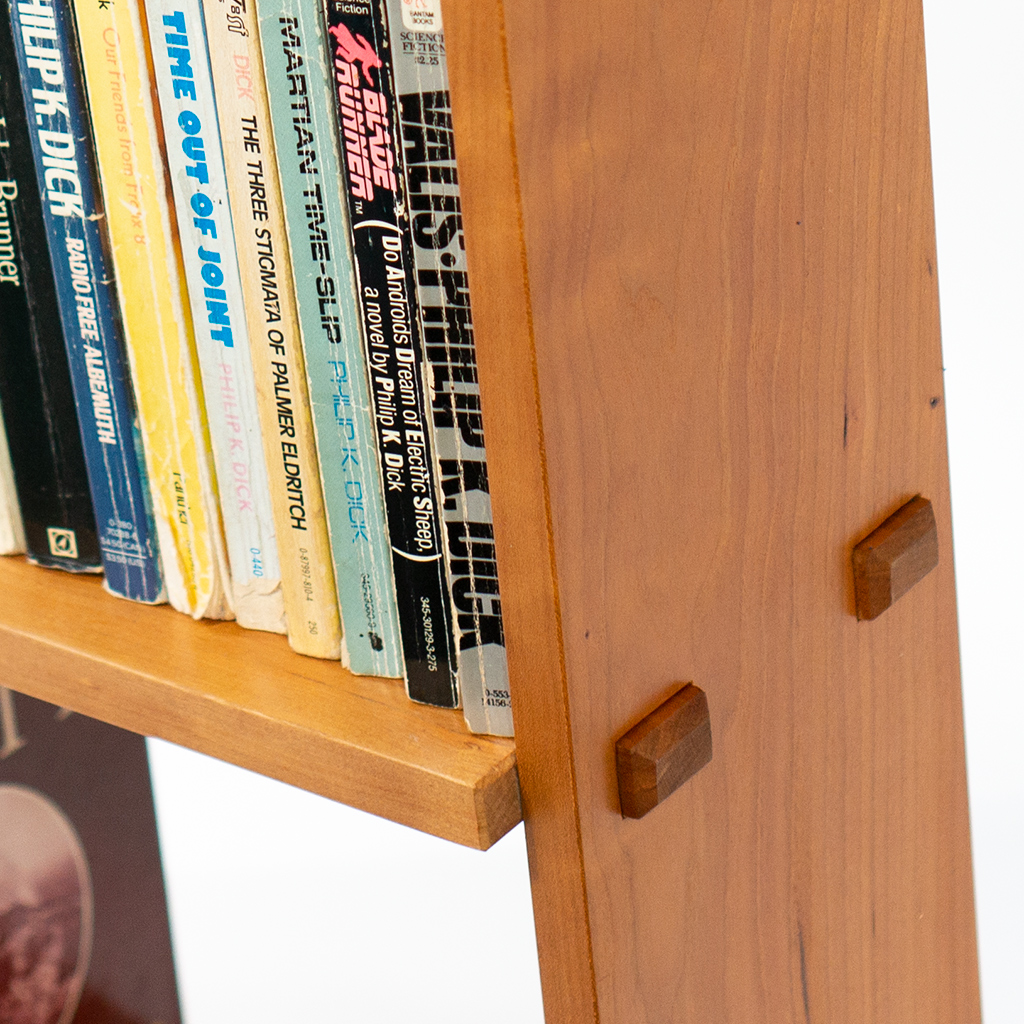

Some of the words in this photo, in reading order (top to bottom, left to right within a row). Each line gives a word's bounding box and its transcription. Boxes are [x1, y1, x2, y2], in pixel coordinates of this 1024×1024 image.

[335, 2, 369, 15] Fiction
[102, 27, 121, 65] Our
[162, 10, 197, 101] TIME
[32, 87, 71, 125] K.
[108, 68, 133, 134] Friends
[233, 53, 255, 101] DICK
[119, 138, 135, 177] from
[177, 109, 210, 185] OUT
[240, 115, 261, 154] THE
[334, 58, 374, 203] RUNNER
[362, 87, 398, 193] BLADE
[37, 129, 86, 217] DICK
[246, 159, 269, 223] THREE
[278, 16, 318, 175] MARTIAN
[302, 183, 342, 345] TIME-SLIP
[190, 192, 218, 240] OF
[65, 237, 93, 294] RADIO
[254, 227, 282, 324] STIGMATA
[363, 286, 380, 298] a
[74, 295, 100, 341] FREE
[197, 245, 234, 348] JOINT
[386, 266, 409, 345] Androids
[267, 329, 286, 356] OF
[365, 305, 389, 350] novel
[369, 352, 391, 374] by
[394, 347, 416, 406] Dream
[83, 344, 117, 445] ALBEMUTH
[271, 361, 296, 439] PALMER
[375, 375, 398, 426] Philip
[402, 409, 423, 426] of
[218, 362, 242, 435] PHILIP
[232, 462, 253, 513] DICK
[328, 360, 356, 441] PHILIP
[344, 480, 369, 544] DICK
[381, 428, 402, 448] K.
[405, 429, 430, 493] Electric
[280, 441, 308, 531] ELDRITCH
[384, 452, 406, 493] Dick
